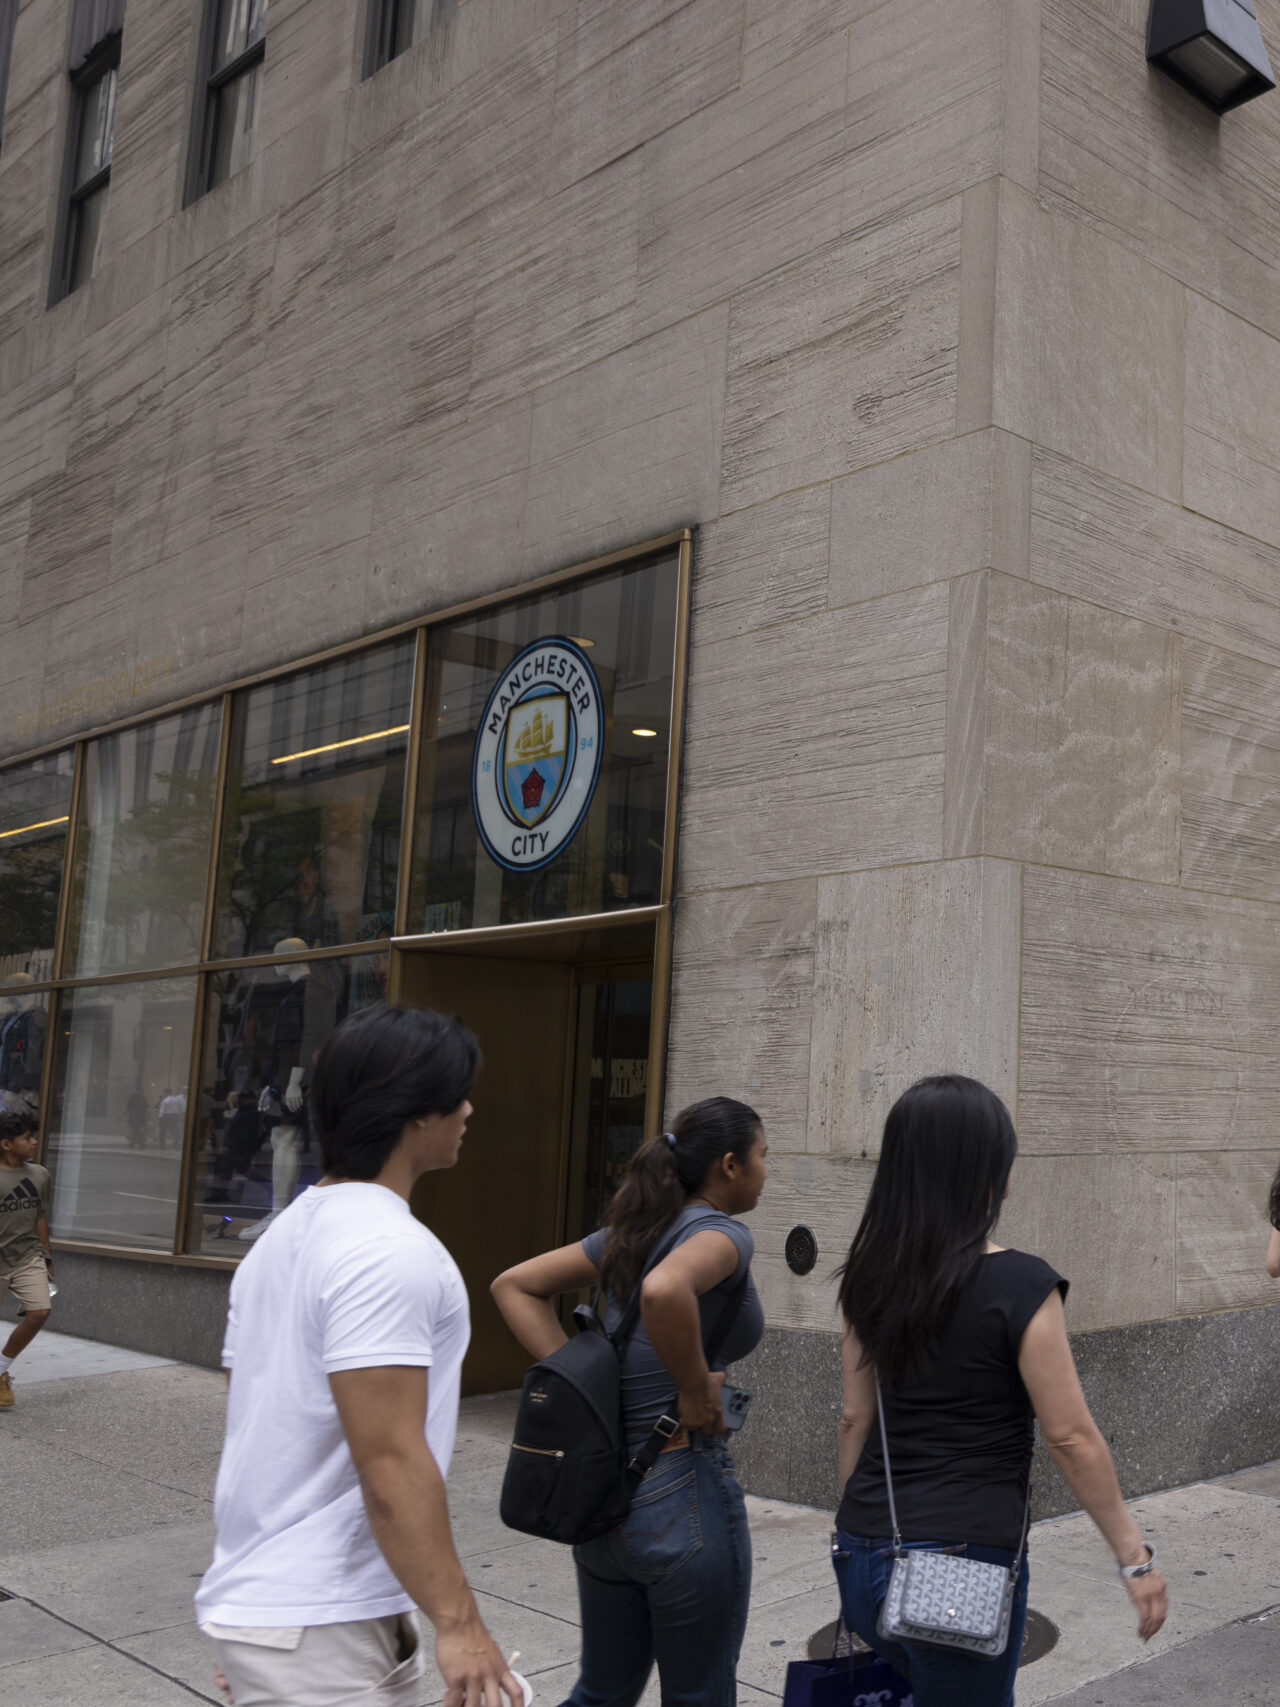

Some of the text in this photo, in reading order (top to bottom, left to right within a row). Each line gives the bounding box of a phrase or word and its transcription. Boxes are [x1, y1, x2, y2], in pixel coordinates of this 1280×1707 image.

[488, 655, 590, 735] MANCHESTER
[580, 736, 594, 750] 94
[482, 760, 491, 772] 18
[511, 831, 550, 857] CITY
